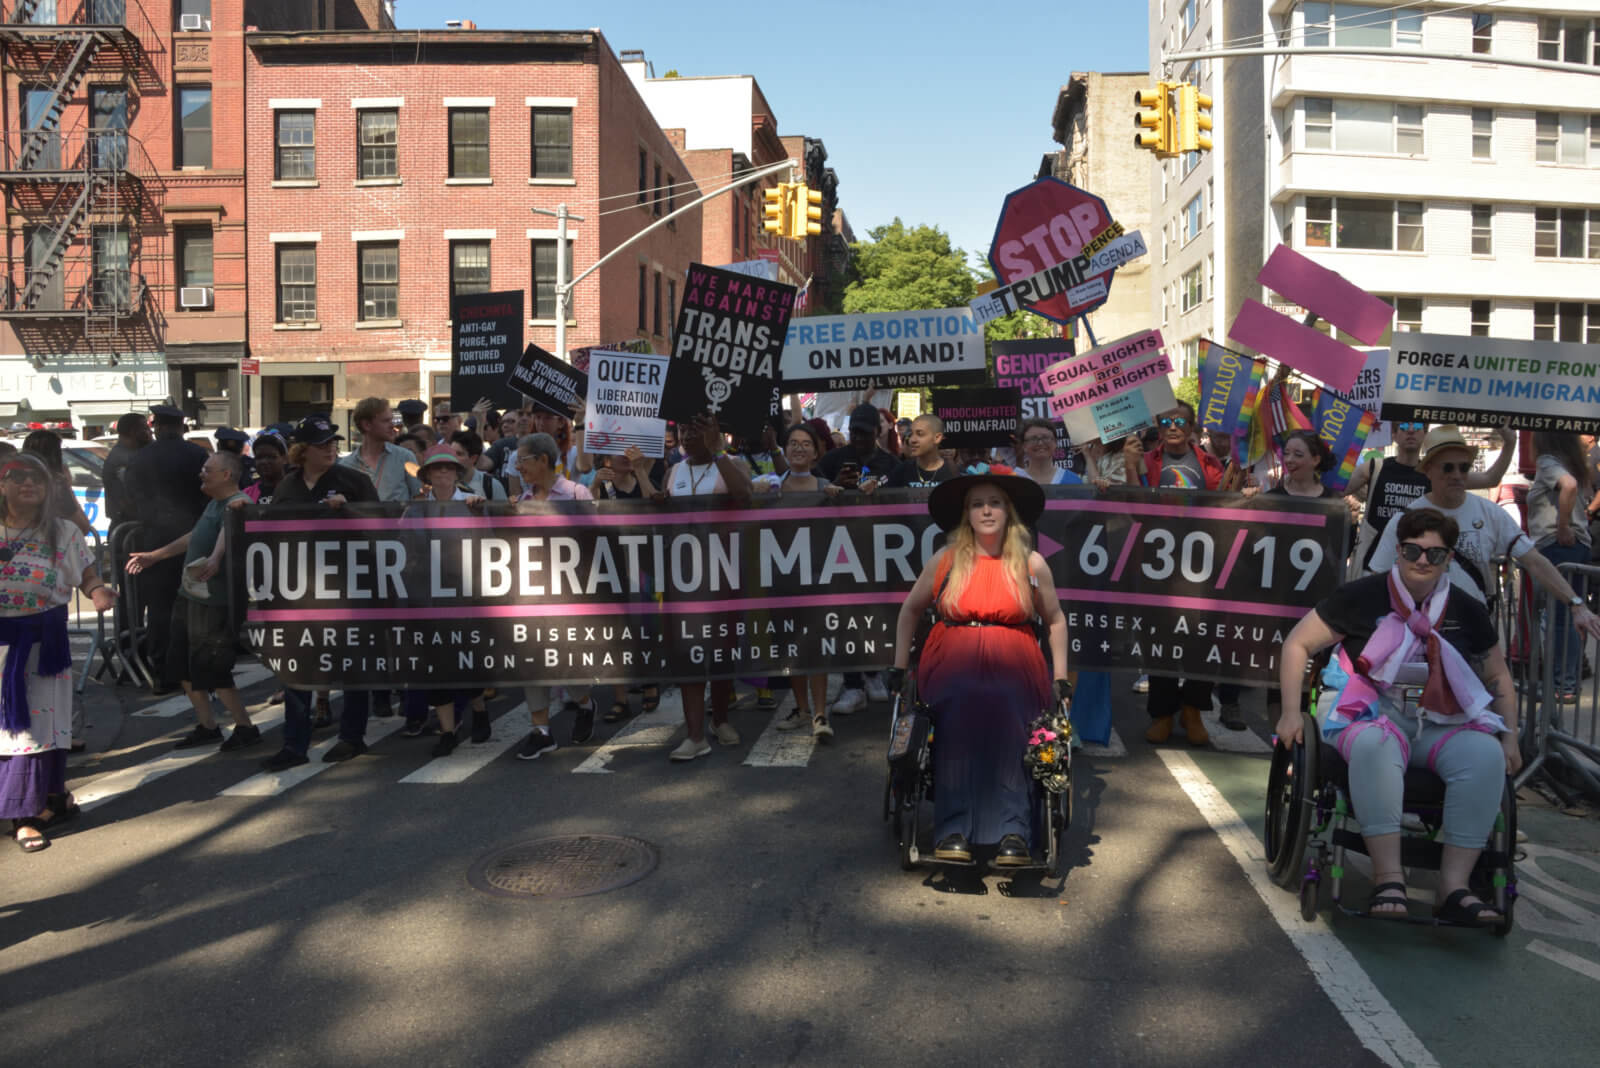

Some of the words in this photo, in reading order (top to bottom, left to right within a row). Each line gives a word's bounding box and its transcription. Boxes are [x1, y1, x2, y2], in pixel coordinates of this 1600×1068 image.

[999, 202, 1099, 282] STOP
[1084, 222, 1124, 257] PENCE
[691, 271, 719, 289] WE
[728, 279, 791, 306] MARCH
[976, 299, 1003, 319] THE
[991, 256, 1091, 318] TRUMP
[1090, 239, 1144, 272] AGENDA
[688, 288, 788, 324] AGAINST
[459, 322, 497, 333] ANTI-GAY
[459, 336, 488, 348] PURGE,
[490, 335, 507, 345] MEN
[684, 308, 780, 350] TRANS-
[785, 323, 845, 346] FREE
[852, 315, 978, 342] ABORTION
[459, 349, 500, 361] TORTURED
[459, 365, 476, 375] AND
[478, 363, 505, 374] KILLED
[675, 334, 773, 379] PHOBIA
[809, 349, 841, 370] ON
[850, 341, 964, 367] DEMAND!
[1047, 361, 1098, 386] EQUAL
[1102, 336, 1157, 365] RIGHTS
[1397, 351, 1455, 368] FORGE
[1458, 355, 1469, 369] A
[1474, 355, 1541, 374] UNITED
[1546, 360, 1600, 378] FRON
[514, 366, 534, 383] WAS
[532, 376, 547, 391] AN
[545, 381, 577, 404] UPRISI
[531, 359, 577, 393] STONEWALL
[598, 359, 661, 386] QUEER
[829, 377, 883, 389] RADICAL
[888, 374, 935, 385] WOMEN
[1052, 383, 1109, 411] HUMAN
[1113, 360, 1167, 389] RIGHTS
[1096, 365, 1120, 380] are
[1395, 373, 1482, 395] DEFEND
[595, 403, 659, 418] WORLDWIDE
[597, 388, 658, 405] LIBERATION
[938, 405, 1017, 419] UNDOCUMENTED
[943, 421, 961, 433] ND
[963, 419, 1017, 432] UNAFRAID
[1413, 408, 1476, 423] FREEDOM
[1480, 414, 1552, 429] SOCALIST
[1555, 419, 1600, 432] PARTY
[1384, 482, 1425, 496] SOCIALIST
[246, 540, 408, 601] QUEER
[430, 533, 740, 598] LIBERATION
[759, 523, 941, 588] MAR
[1079, 522, 1324, 591] 6/30/19
[248, 628, 285, 647] WE
[299, 627, 375, 646] ARE:
[392, 626, 495, 647] TRANS,
[513, 623, 664, 643] BISEXUAL,
[681, 619, 808, 639] LESBIAN,
[825, 612, 888, 632] GAY,
[1068, 612, 1156, 635] ERSEX,
[1174, 615, 1284, 644] ASEXUA
[319, 653, 433, 673] SPIRIT,
[458, 648, 667, 670] NON-BINARY,
[690, 643, 798, 664] GENDER
[1131, 642, 1183, 660] AND
[1206, 644, 1275, 669] ALLI
